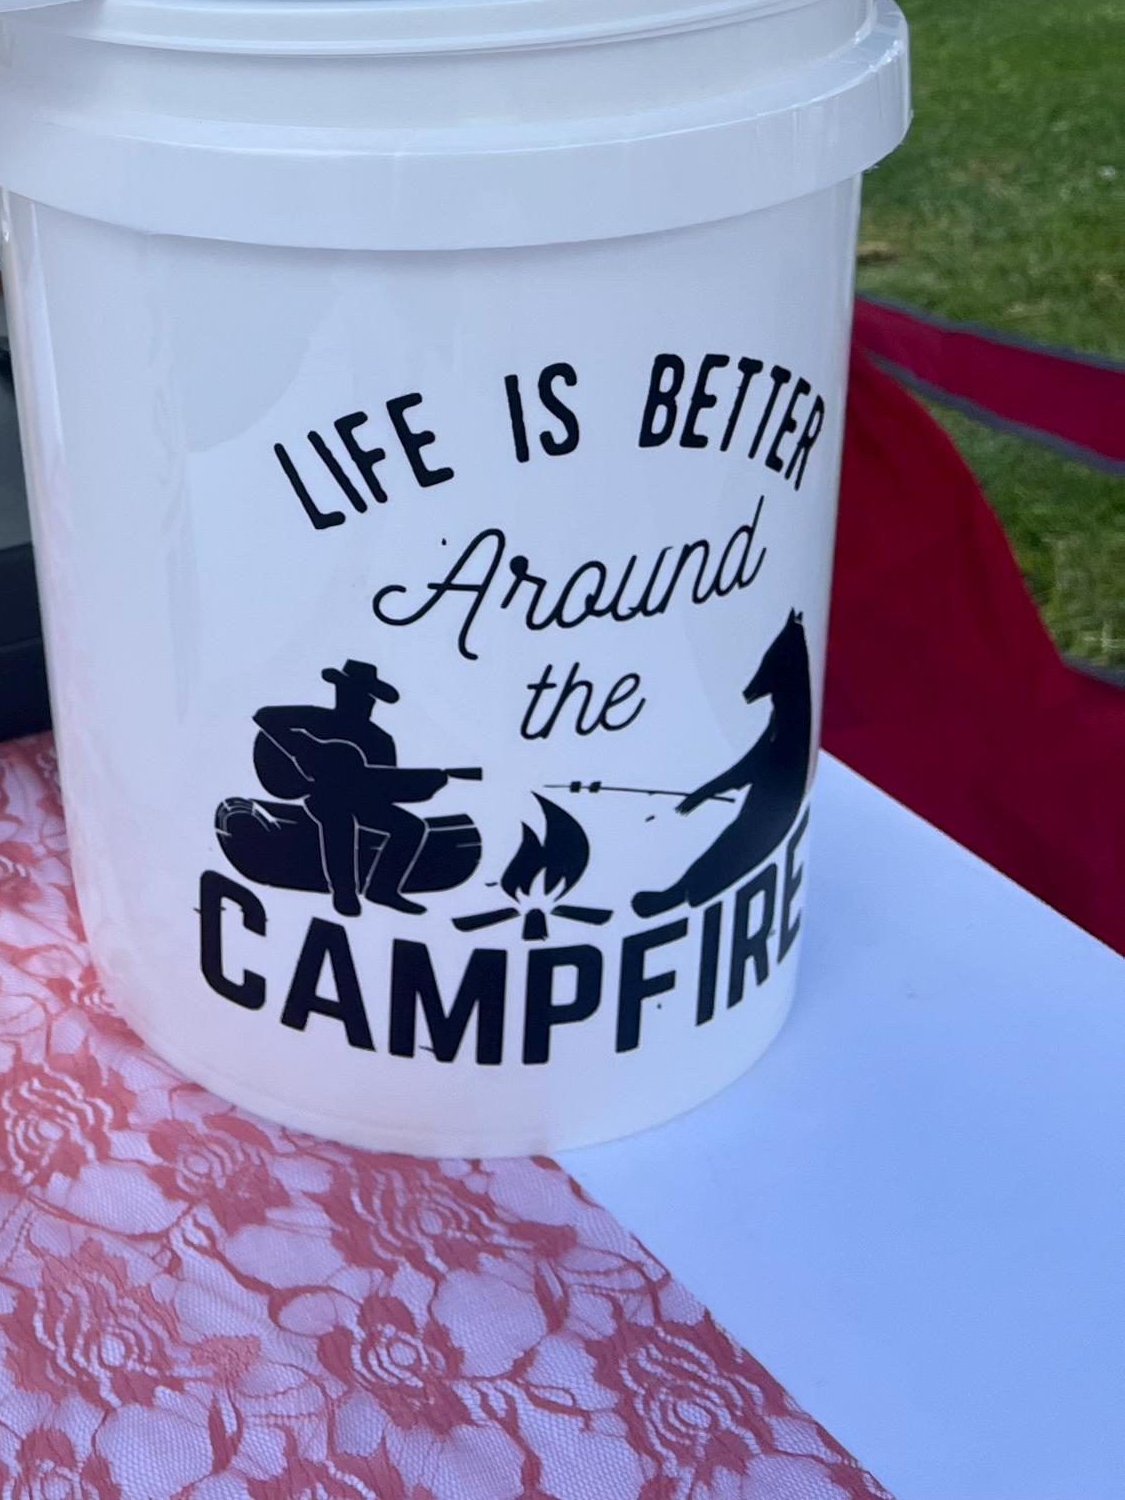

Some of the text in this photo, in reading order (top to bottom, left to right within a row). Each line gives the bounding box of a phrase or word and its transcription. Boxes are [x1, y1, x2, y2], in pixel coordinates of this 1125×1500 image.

[274, 353, 825, 530] LIFE IS BETTER
[372, 495, 767, 661] Around
[520, 661, 646, 740] the
[199, 802, 811, 1066] CAMPFIRE
